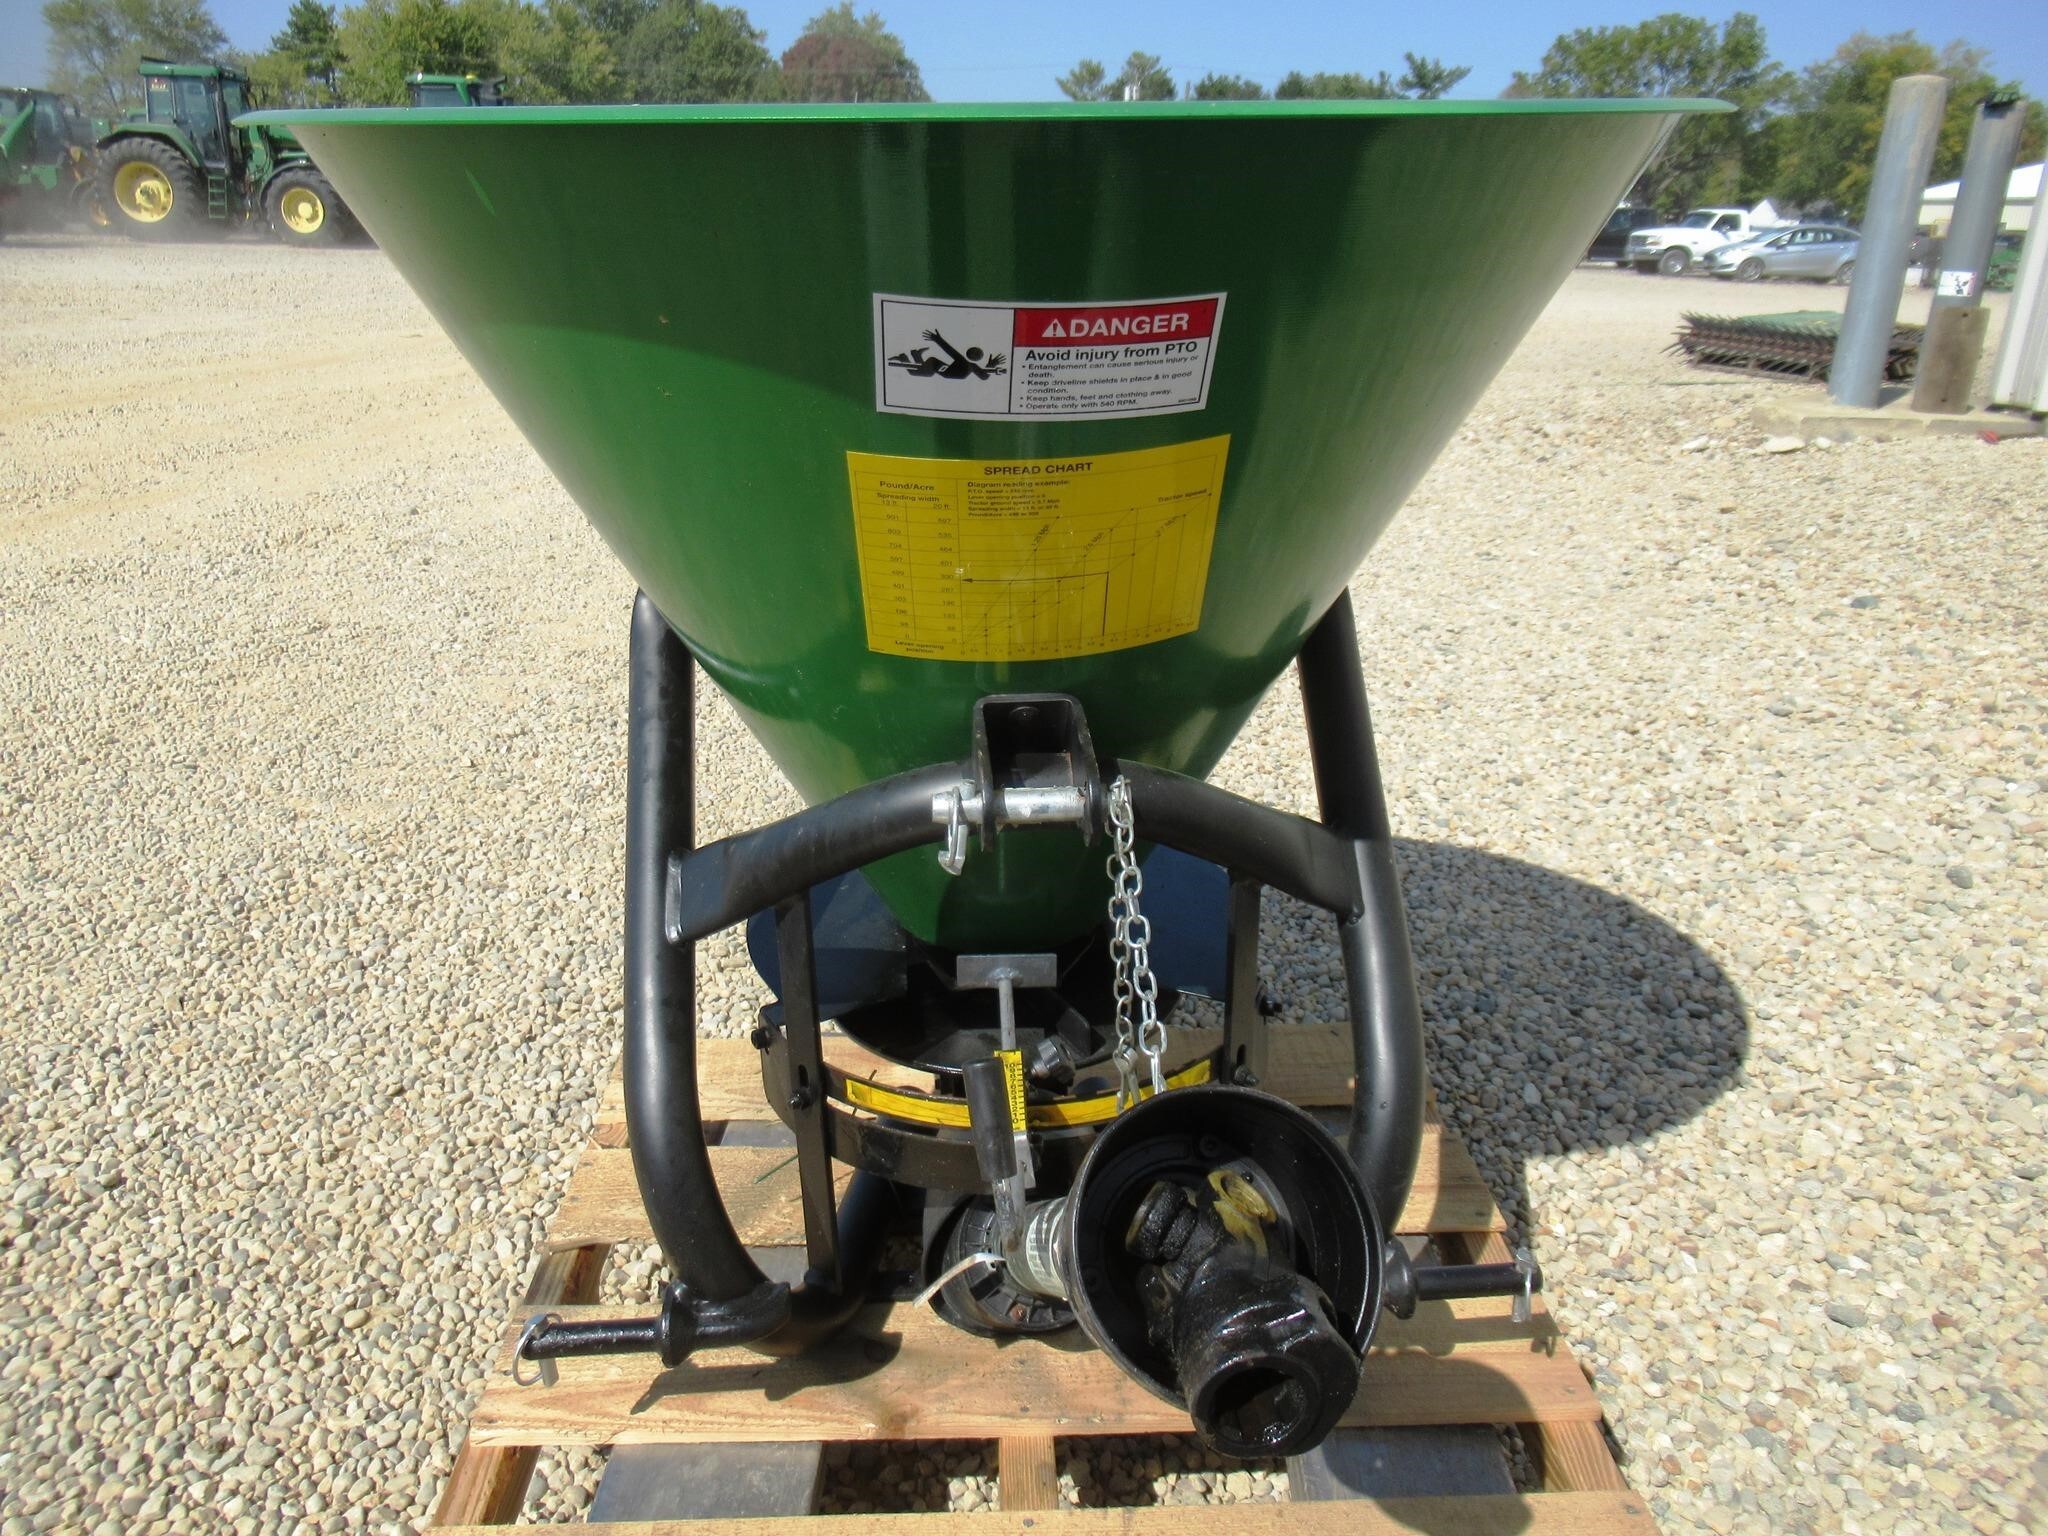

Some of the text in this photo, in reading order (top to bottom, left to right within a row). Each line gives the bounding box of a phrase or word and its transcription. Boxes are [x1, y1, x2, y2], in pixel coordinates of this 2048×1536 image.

[1069, 313, 1190, 338] DANGER
[1025, 341, 1198, 363] Avoid injury from PTO
[1028, 363, 1087, 371] Entanglement
[1166, 356, 1188, 364] injury
[1089, 377, 1119, 385] shields
[1130, 375, 1152, 383] place
[1171, 371, 1193, 380] good
[1098, 392, 1113, 400] and
[1115, 391, 1148, 399] clothing
[1026, 402, 1059, 410] Operate
[1061, 401, 1079, 409] only
[1100, 400, 1115, 408] 540
[984, 462, 1094, 476] SPREAD CHART
[879, 480, 935, 491] Pound/Acre
[876, 492, 916, 502] Spreading
